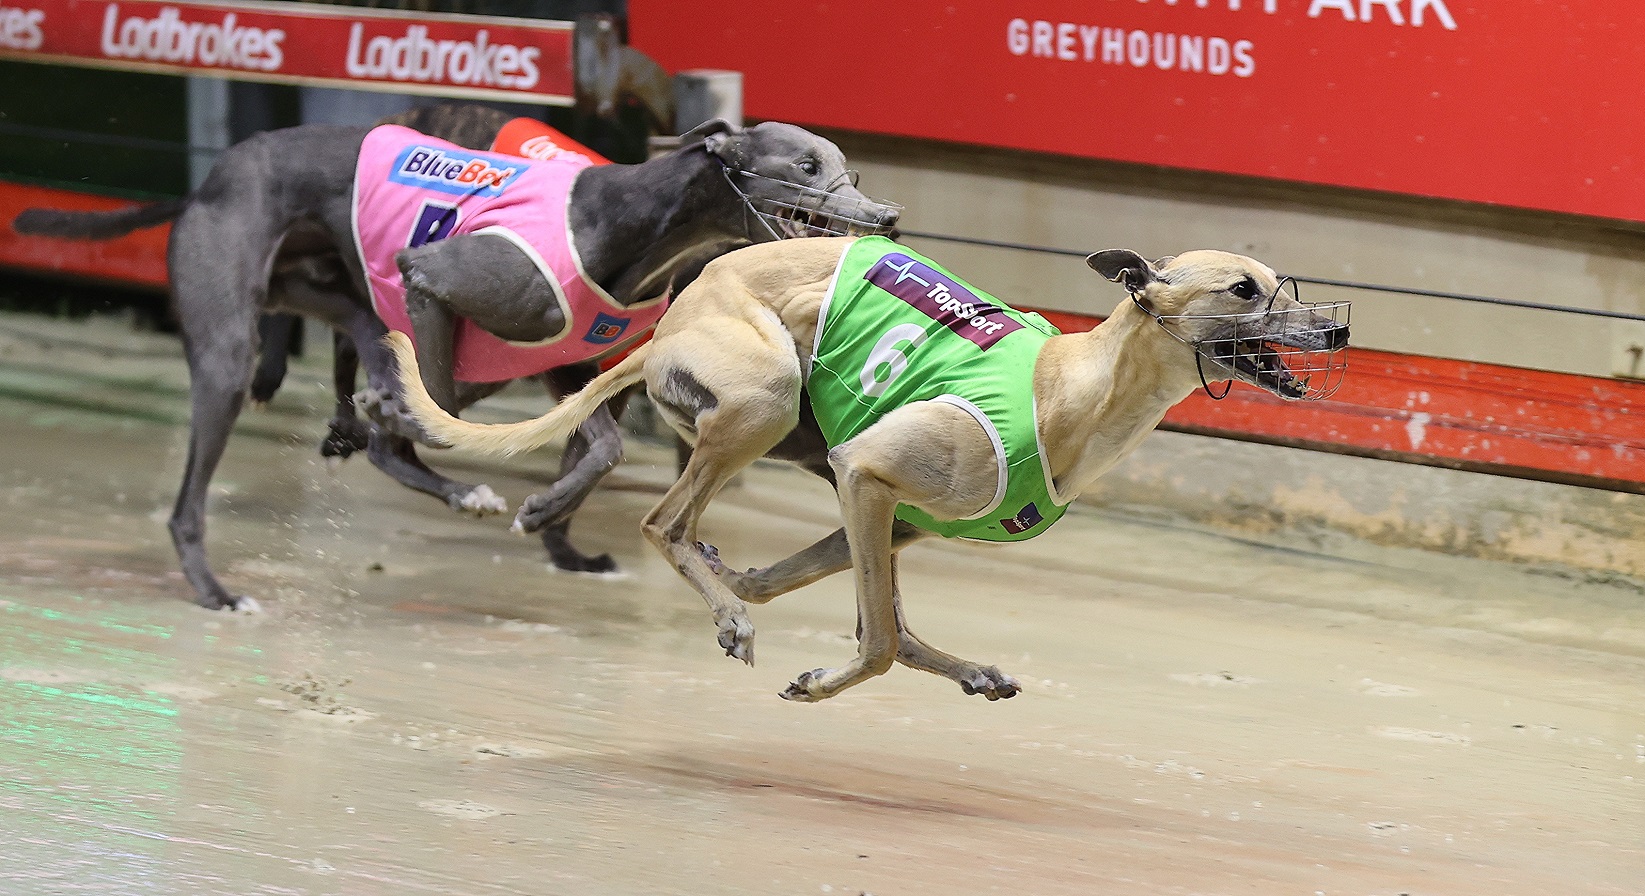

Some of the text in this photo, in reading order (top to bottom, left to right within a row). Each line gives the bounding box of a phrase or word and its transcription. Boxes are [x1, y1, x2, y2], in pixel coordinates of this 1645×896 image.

[0, 6, 45, 49] es
[102, 4, 285, 72] Ladbrokes
[346, 22, 541, 90] Ladbrokes
[1006, 18, 1256, 78] GREYHOUNDS
[402, 147, 516, 190] BlueBet
[592, 322, 621, 338] BB
[859, 323, 928, 398] 6
